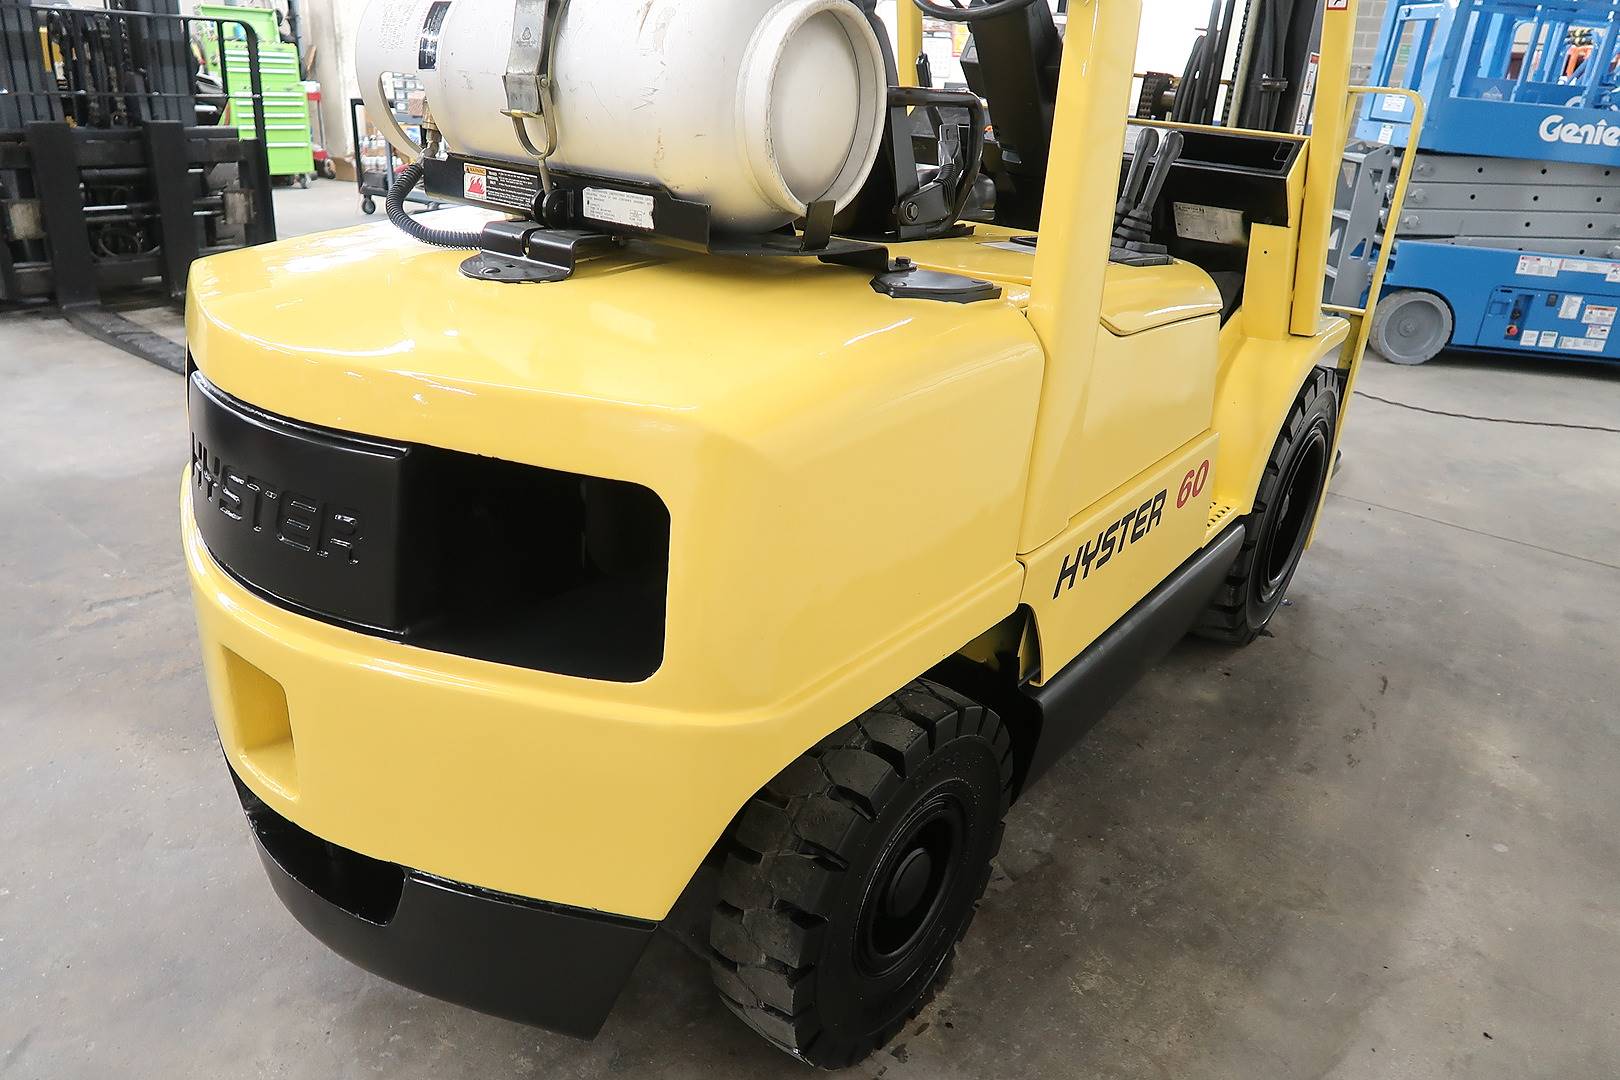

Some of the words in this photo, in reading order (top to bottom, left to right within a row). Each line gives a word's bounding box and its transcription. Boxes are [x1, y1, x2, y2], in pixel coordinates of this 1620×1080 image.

[1539, 115, 1620, 147] Genie
[192, 431, 367, 564] HYSTER
[1053, 488, 1168, 600] HYSTER
[1176, 459, 1210, 509] 60
